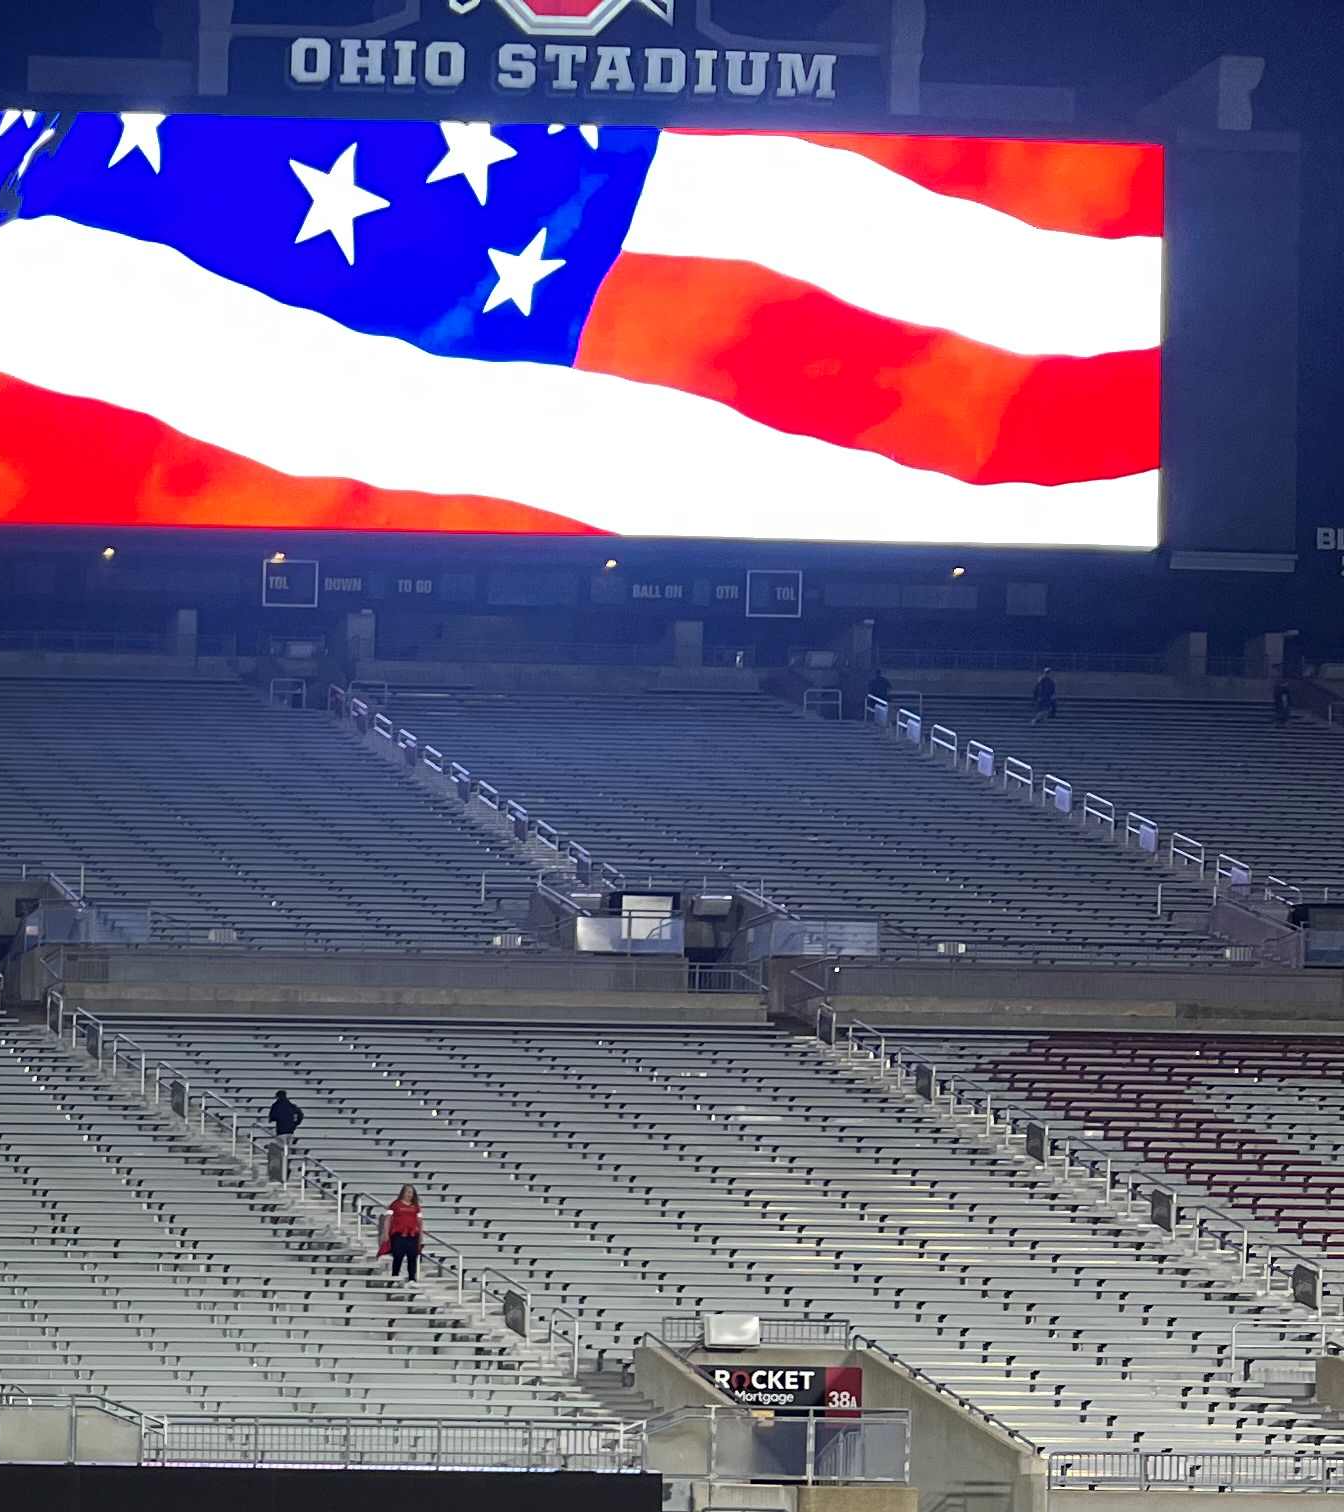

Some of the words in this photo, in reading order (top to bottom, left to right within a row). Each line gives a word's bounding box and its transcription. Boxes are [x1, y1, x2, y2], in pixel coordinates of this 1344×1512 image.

[290, 37, 465, 87] OHIO
[497, 44, 837, 99] STADIUM
[324, 577, 362, 592] DOWN
[398, 579, 412, 593] TO
[633, 584, 661, 599] BALL
[776, 586, 797, 601] TOL
[715, 1368, 815, 1391] ROCKET
[734, 1390, 794, 1405] Mortgage
[828, 1391, 857, 1408] 38A
